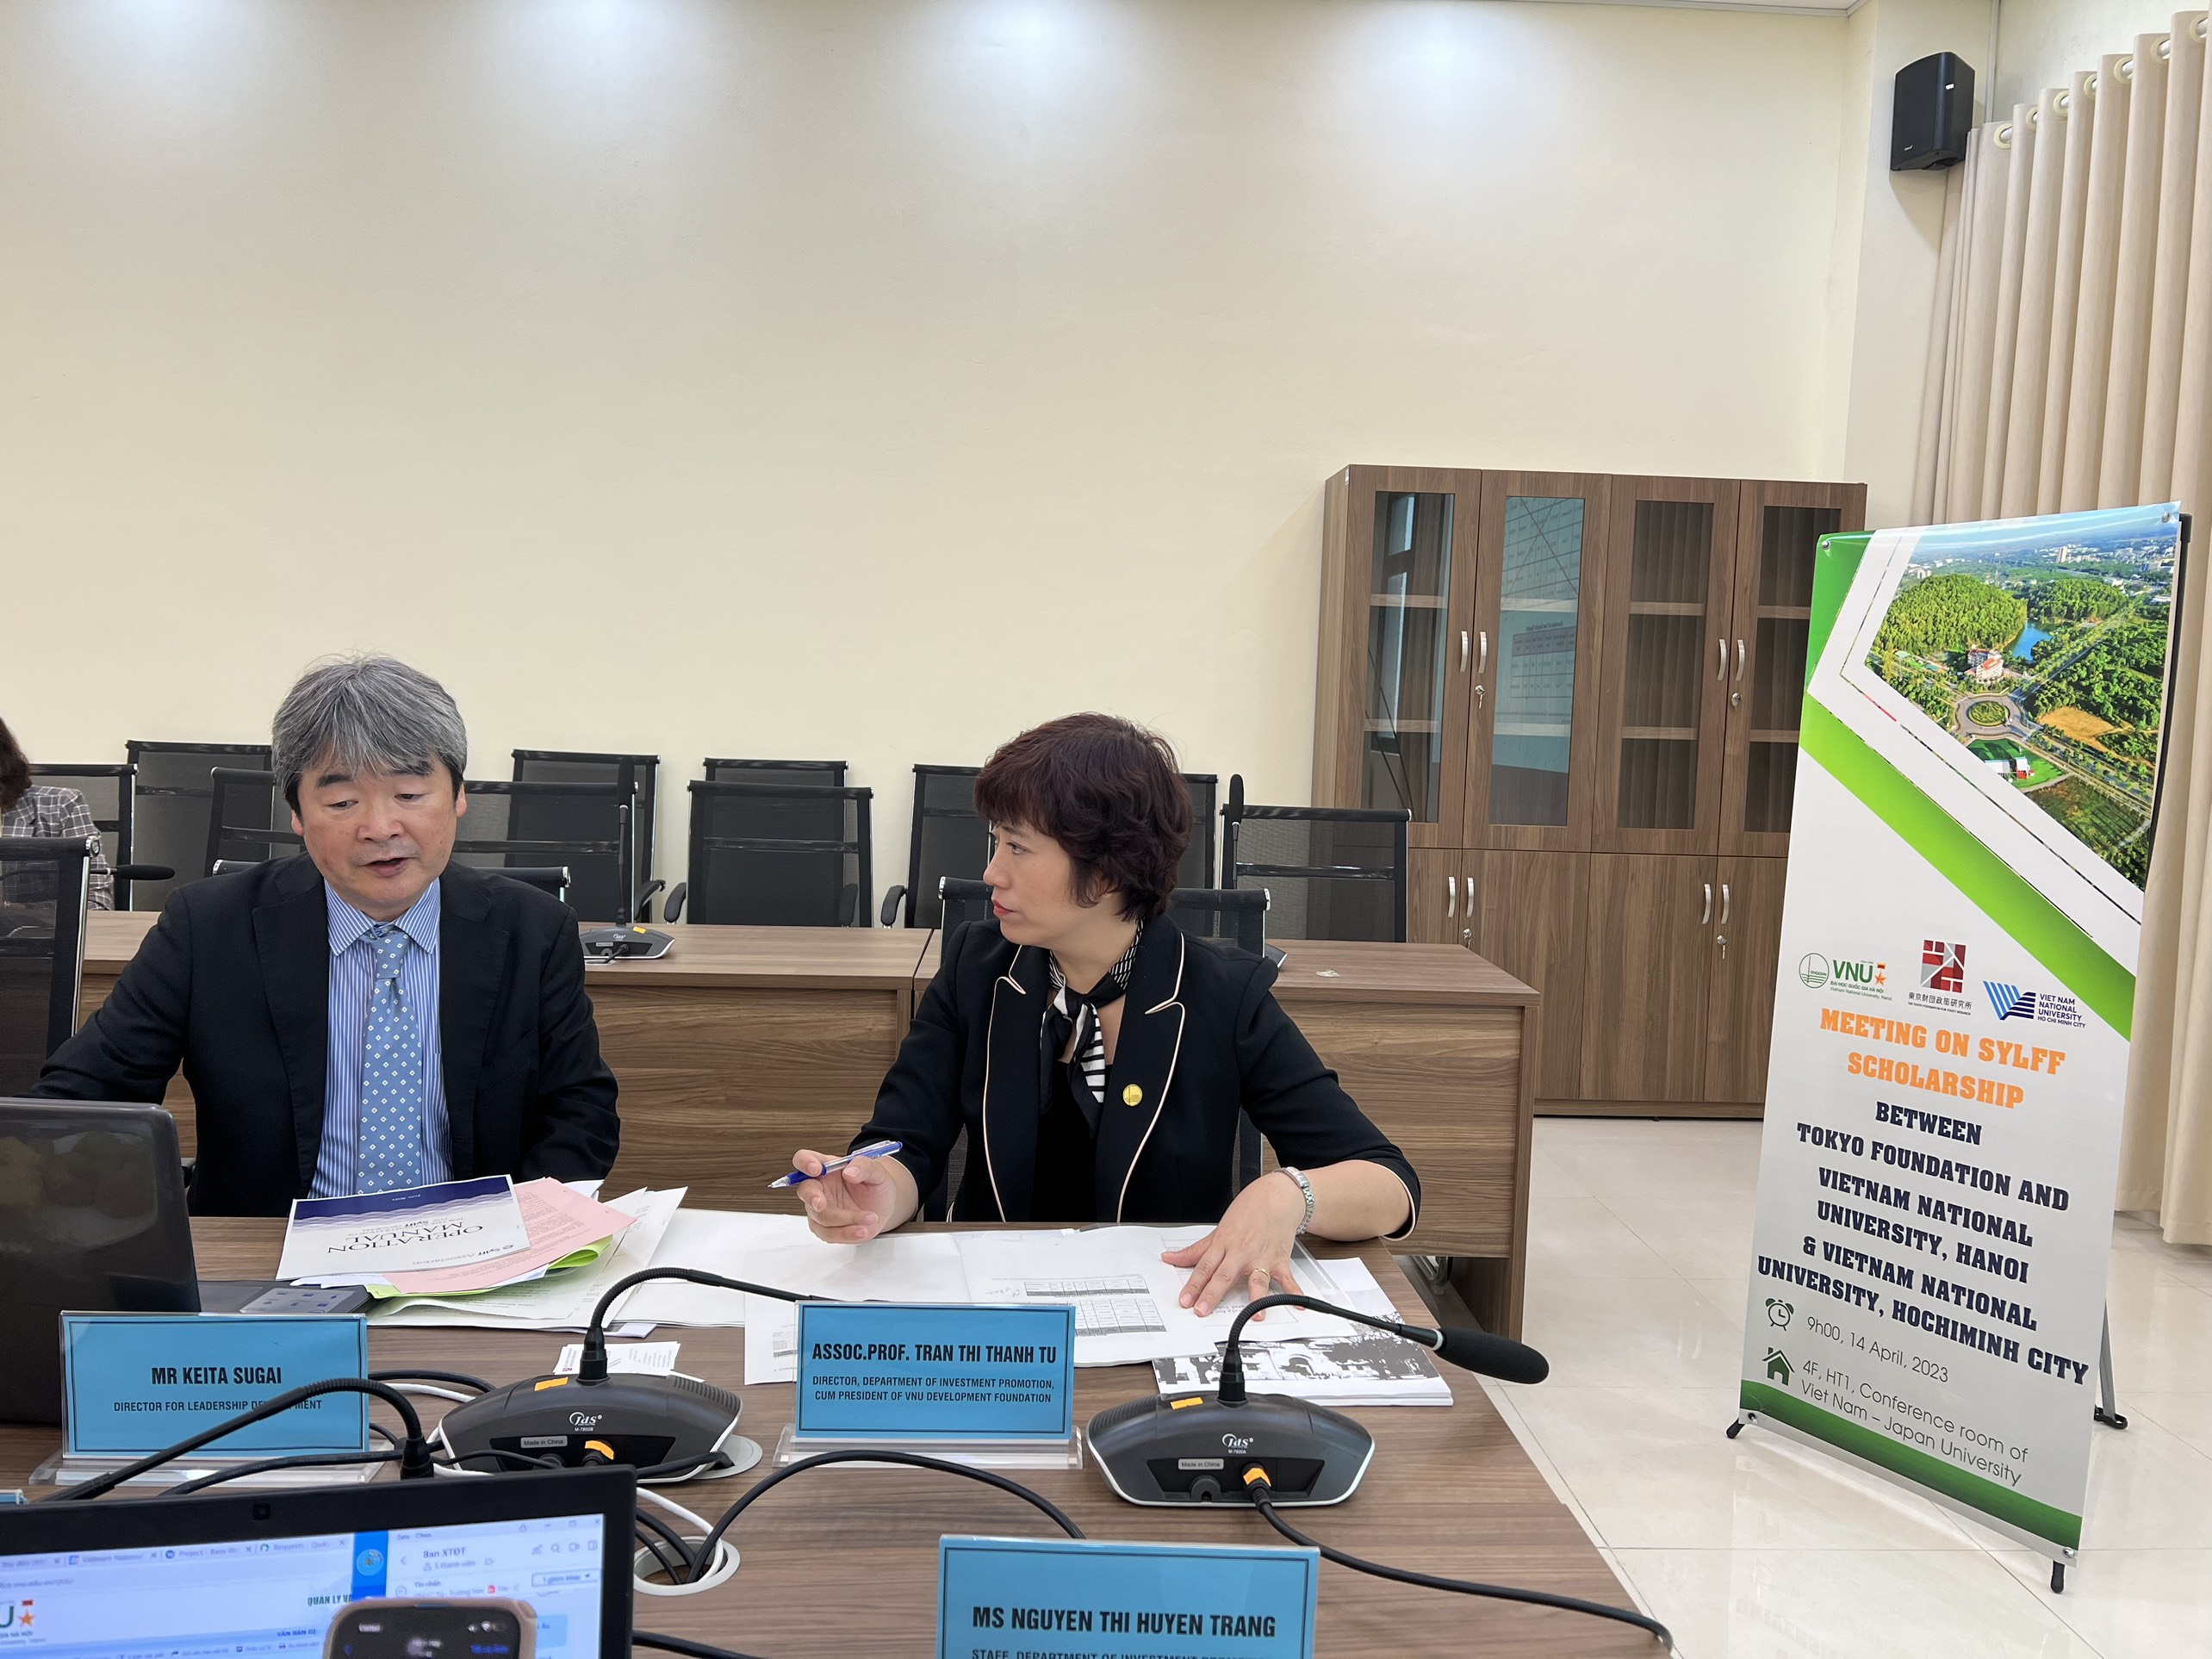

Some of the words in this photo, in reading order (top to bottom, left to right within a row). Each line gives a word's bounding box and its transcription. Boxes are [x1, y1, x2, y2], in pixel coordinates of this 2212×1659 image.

[1832, 960, 1873, 984] VNU
[2038, 1008, 2083, 1022] UNIVERSITY
[2039, 1001, 2077, 1014] NATIONAL
[1820, 1008, 1927, 1049] MEETING
[1936, 1029, 1969, 1058] ON
[1979, 1037, 2066, 1075] SYLFF
[1847, 1052, 2024, 1109] SCHOLARSHIP
[1875, 1101, 1983, 1146] BETWEEN
[1797, 1122, 1864, 1156] TOKYO
[1871, 1140, 2011, 1196] FOUNDATION
[2018, 1179, 2069, 1212] AND
[1818, 1166, 1911, 1211] VIETNAM
[1917, 1196, 2033, 1247] NATIONAL
[327, 1225, 484, 1254] OPERATION
[345, 1221, 463, 1244] MANUAL
[1817, 1200, 1948, 1261] UNIVERSITY,
[1955, 1242, 2029, 1283] HANOI
[1803, 1235, 1816, 1258] &
[1823, 1241, 1914, 1290] VIETNAM
[1922, 1273, 2038, 1332] NATIONAL
[1757, 1256, 1885, 1318] UNIVERSITY,
[1892, 1298, 2019, 1364] HOCHIMINH
[2028, 1346, 2090, 1386] CITY
[812, 1343, 910, 1361] ASSOC.PROF.
[915, 1344, 954, 1362] TRAN
[958, 1345, 982, 1363] THI
[985, 1345, 1034, 1363] THANH
[1039, 1345, 1056, 1364] TU
[1807, 1316, 1843, 1344] 9h00,
[1850, 1332, 1866, 1352] 14
[1869, 1340, 1908, 1369] April,
[1912, 1357, 1949, 1383] 2023
[152, 1367, 177, 1385] MR
[183, 1367, 229, 1384] KEITA
[233, 1366, 282, 1384] SUGAI
[813, 1376, 860, 1387] DIRECTOR,
[863, 1376, 923, 1387] DEPARTMENT
[925, 1377, 937, 1387] OF
[939, 1378, 996, 1389] INVESTMENT
[999, 1378, 1054, 1390] PROMOTION,
[114, 1402, 162, 1411] DIRECTOR
[165, 1401, 184, 1411] FOR
[188, 1401, 248, 1411] LEADERSHIP
[815, 1390, 836, 1401] CUM
[839, 1391, 888, 1401] PRESIDENT
[891, 1392, 903, 1401] OF
[904, 1392, 923, 1401] VNU
[927, 1392, 991, 1402] DEVELOPMENT
[994, 1392, 1051, 1402] FOUNDATION
[1803, 1359, 1822, 1381] 4F,
[1826, 1369, 1854, 1394] HT1,
[1859, 1382, 1955, 1433] Conference
[1960, 1425, 2005, 1454] room
[2010, 1445, 2029, 1463] of
[1801, 1378, 1828, 1404] Viet
[1832, 1392, 1867, 1421] Nam
[1884, 1416, 1936, 1453] Japan
[1941, 1439, 2022, 1488] University
[972, 1606, 1004, 1629] MS
[1011, 1607, 1092, 1632] NGUYEN
[1099, 1611, 1130, 1633] THI
[1137, 1612, 1202, 1636] HUYEN
[1210, 1614, 1277, 1637] TRANG
